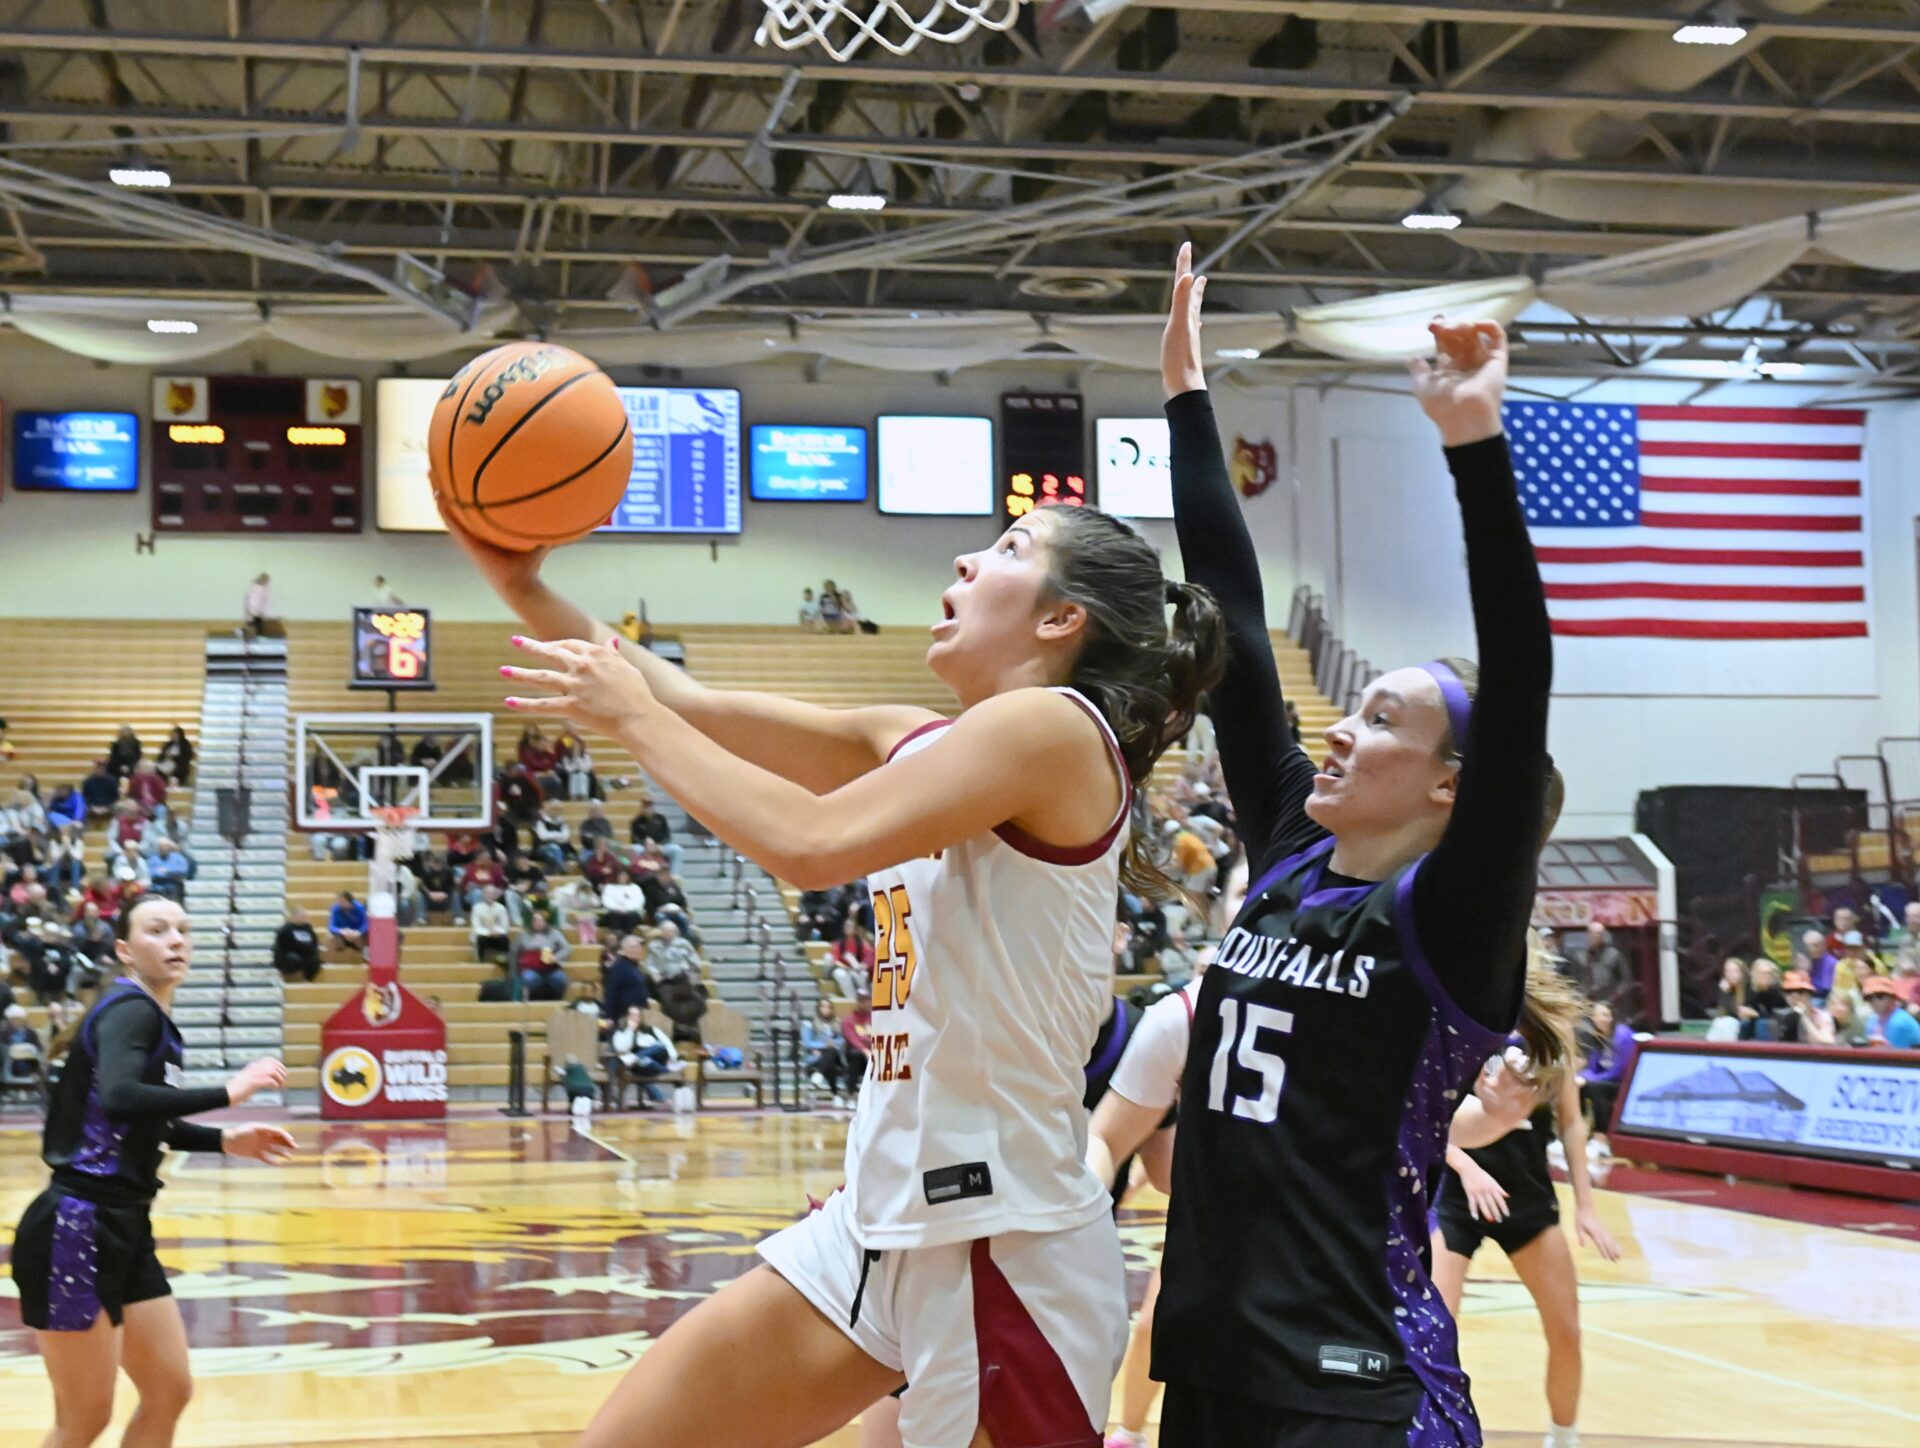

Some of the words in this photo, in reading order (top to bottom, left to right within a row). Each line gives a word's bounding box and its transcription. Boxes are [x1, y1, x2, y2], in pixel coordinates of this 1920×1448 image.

[389, 638, 418, 678] 6
[872, 884, 917, 1010] 25
[384, 1063, 448, 1084] WILD
[1207, 997, 1296, 1125] 15
[968, 1172, 983, 1186] M
[1367, 1358, 1381, 1372] M
